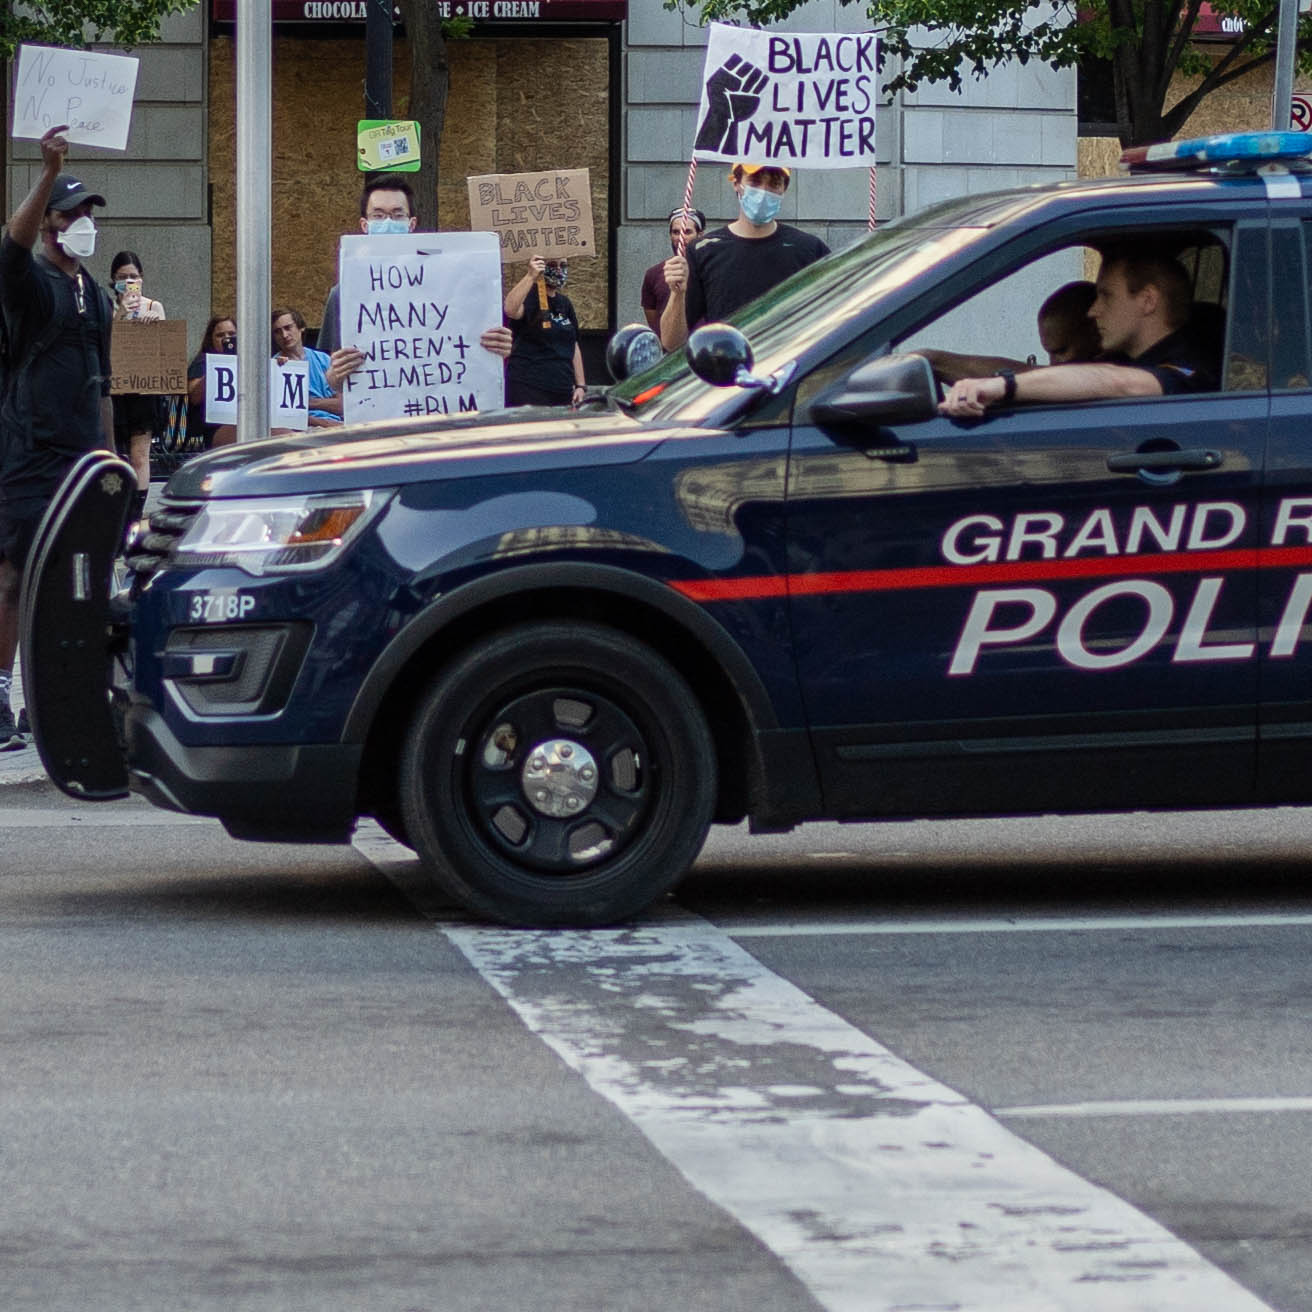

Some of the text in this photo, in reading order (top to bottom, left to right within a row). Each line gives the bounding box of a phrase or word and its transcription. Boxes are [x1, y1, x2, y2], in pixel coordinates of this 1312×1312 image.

[304, 1, 368, 18] CHOCOLA
[468, 1, 489, 18] ICE
[494, 1, 541, 18] CREAM
[22, 51, 56, 87] No
[768, 36, 874, 74] BLACK
[772, 75, 872, 115] LIVES
[744, 117, 876, 159] MATTER
[478, 176, 570, 206] BLACK
[491, 199, 581, 226] LIVES
[370, 264, 424, 292] HOW
[357, 302, 449, 334] MANY
[214, 367, 306, 410] B M
[346, 361, 467, 392] FILMED?
[940, 500, 1247, 566] GRAND
[191, 595, 256, 619] 3718P
